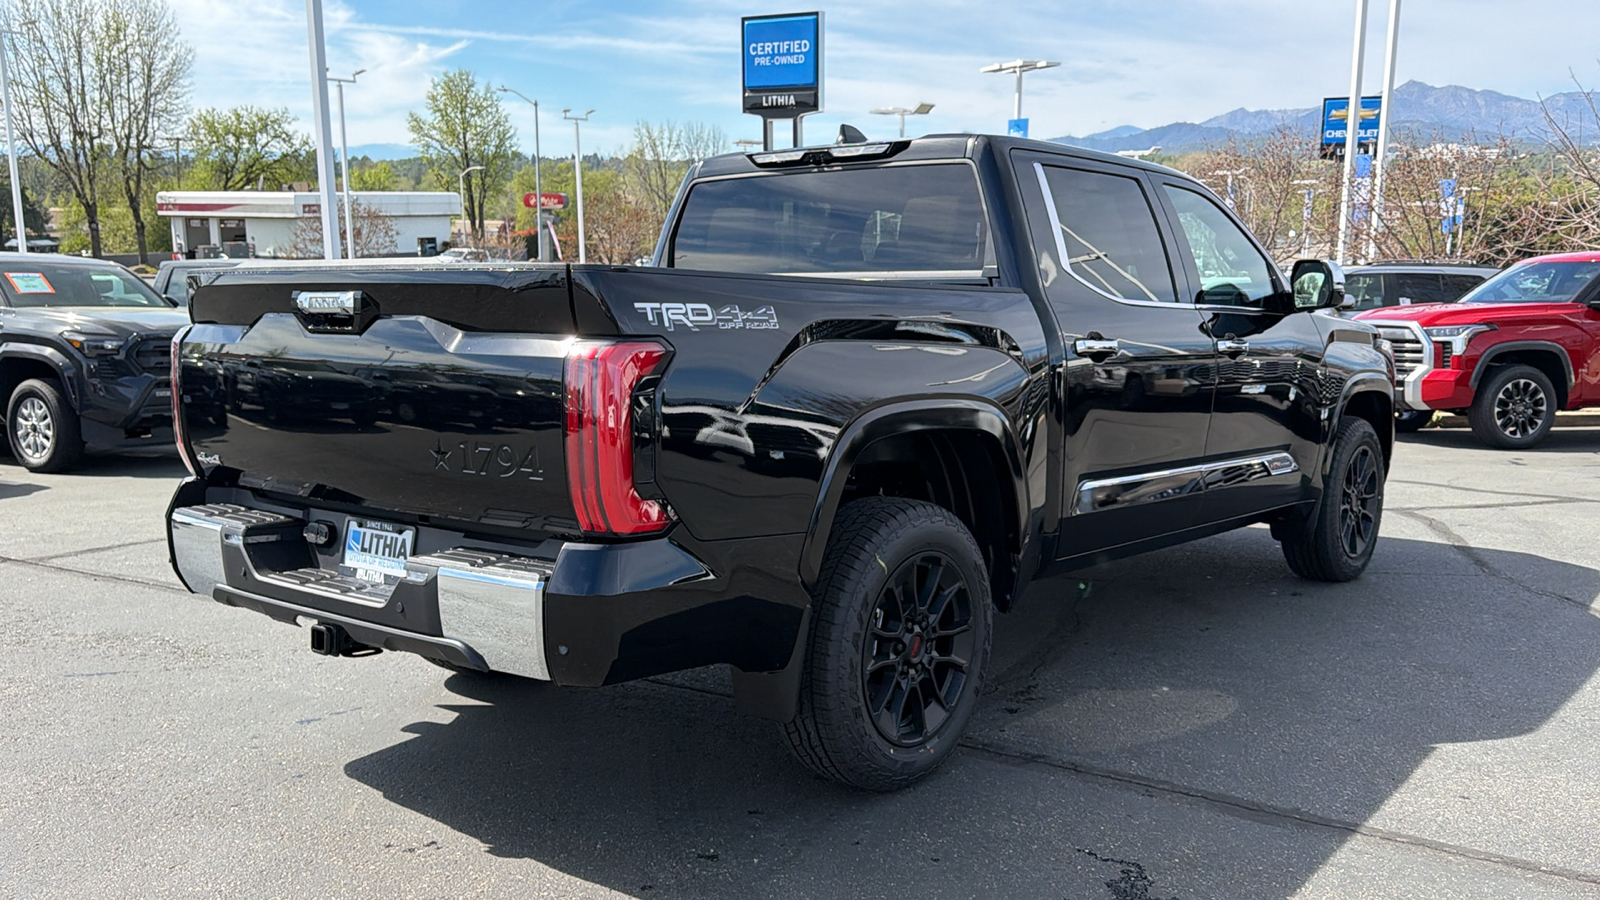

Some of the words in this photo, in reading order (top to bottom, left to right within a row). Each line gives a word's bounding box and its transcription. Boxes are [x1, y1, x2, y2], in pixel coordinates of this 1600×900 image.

[749, 40, 810, 55] CERTIFIED
[754, 55, 805, 66] PRE-OWNED
[762, 95, 796, 106] LITHIA
[1325, 128, 1379, 138] CHEVOLET
[634, 302, 717, 331] TRD
[719, 321, 744, 329] OFF
[745, 322, 780, 330] ROAD
[459, 440, 544, 481] 1794
[366, 520, 381, 530] SINCE
[381, 522, 393, 531] 1946
[360, 531, 408, 560] LITHIA
[368, 555, 377, 566] OF
